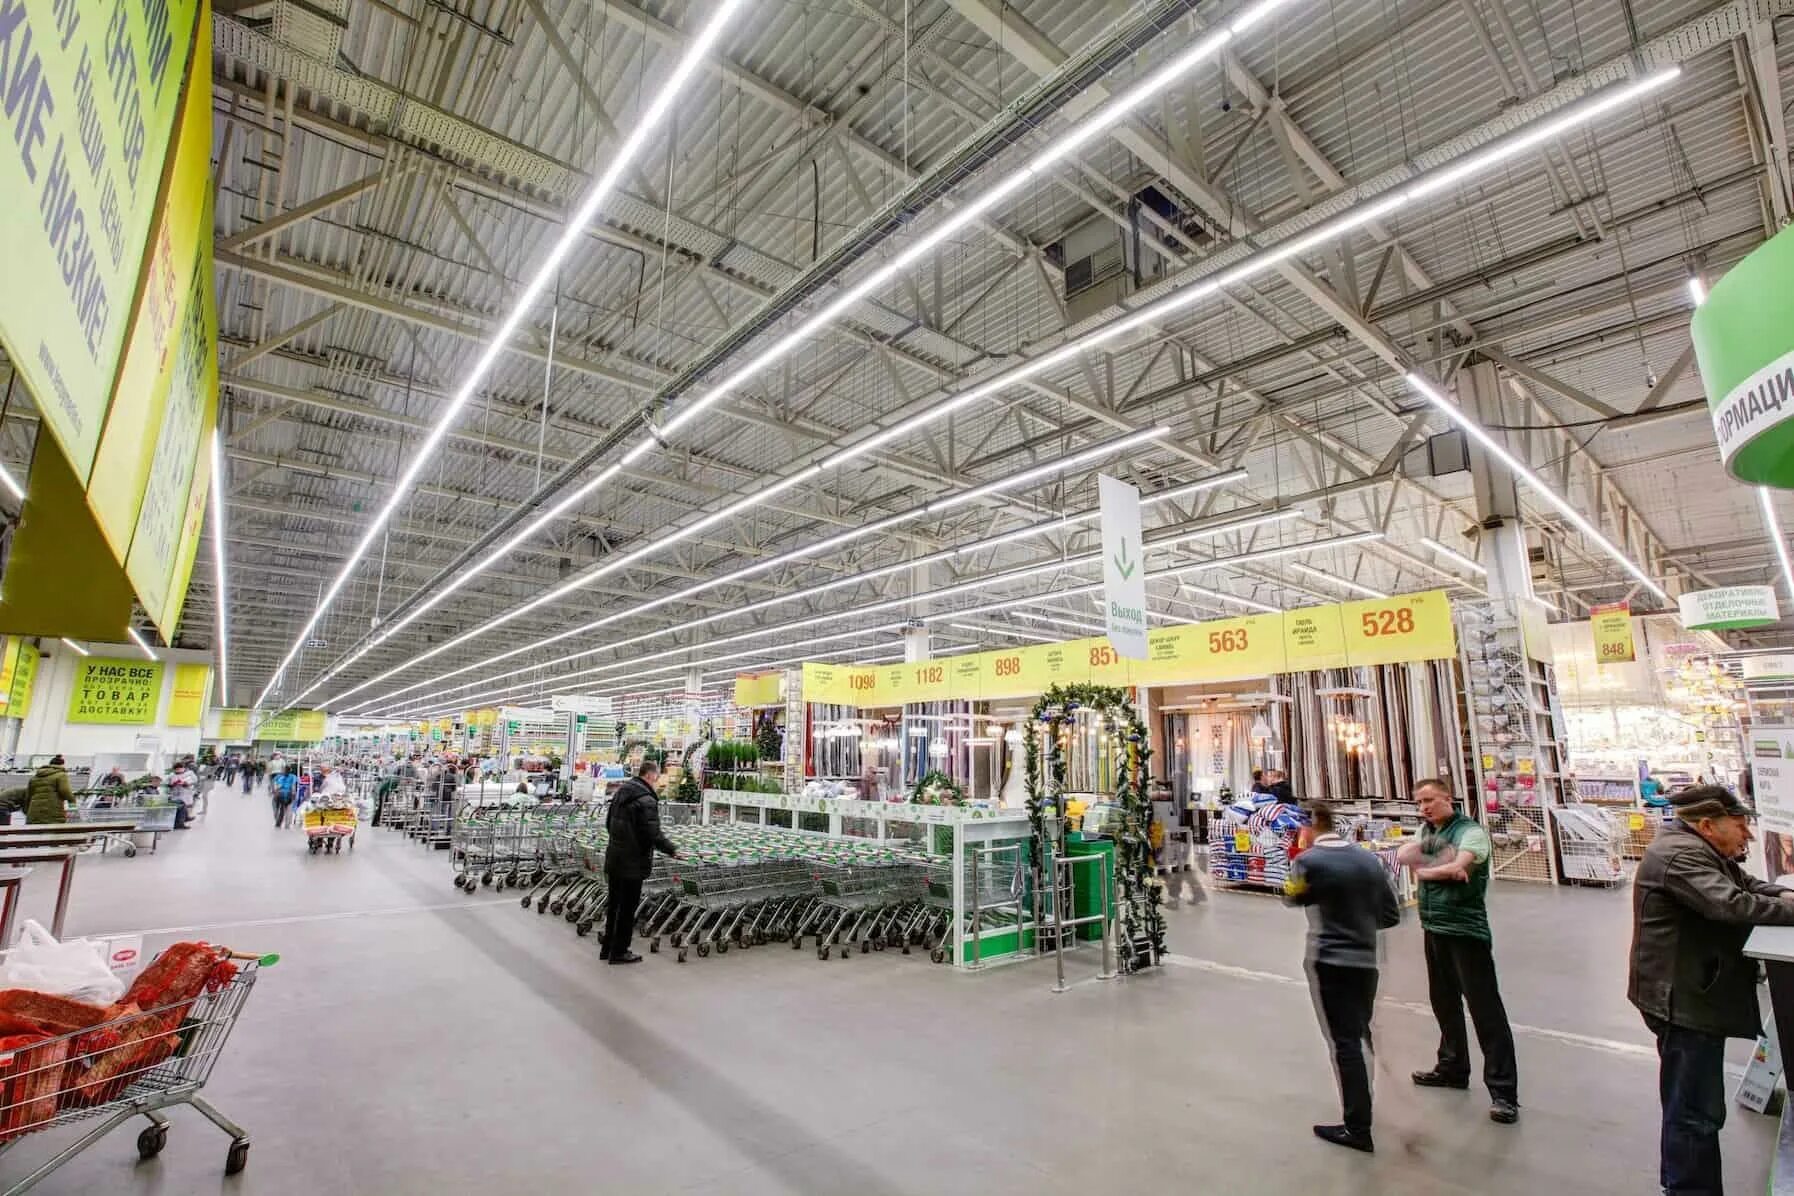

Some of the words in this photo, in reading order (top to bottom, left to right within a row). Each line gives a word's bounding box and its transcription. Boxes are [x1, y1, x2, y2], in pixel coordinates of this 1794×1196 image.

[73, 41, 106, 189] НАШИ
[100, 167, 125, 273] ЦЕНЫ
[39, 131, 110, 368] НИЗКИЕ!
[1111, 601, 1143, 624] Выход
[1362, 608, 1415, 637] 528
[1209, 629, 1248, 653] 563
[1602, 643, 1625, 656] 848
[995, 656, 1020, 676] 898
[1090, 646, 1119, 666] 851
[87, 665, 97, 675] У
[99, 666, 126, 677] НАС
[129, 668, 153, 679] ВСЕ
[847, 673, 876, 690] 1098
[916, 666, 943, 685] 1182
[82, 689, 150, 702] ТОВАР
